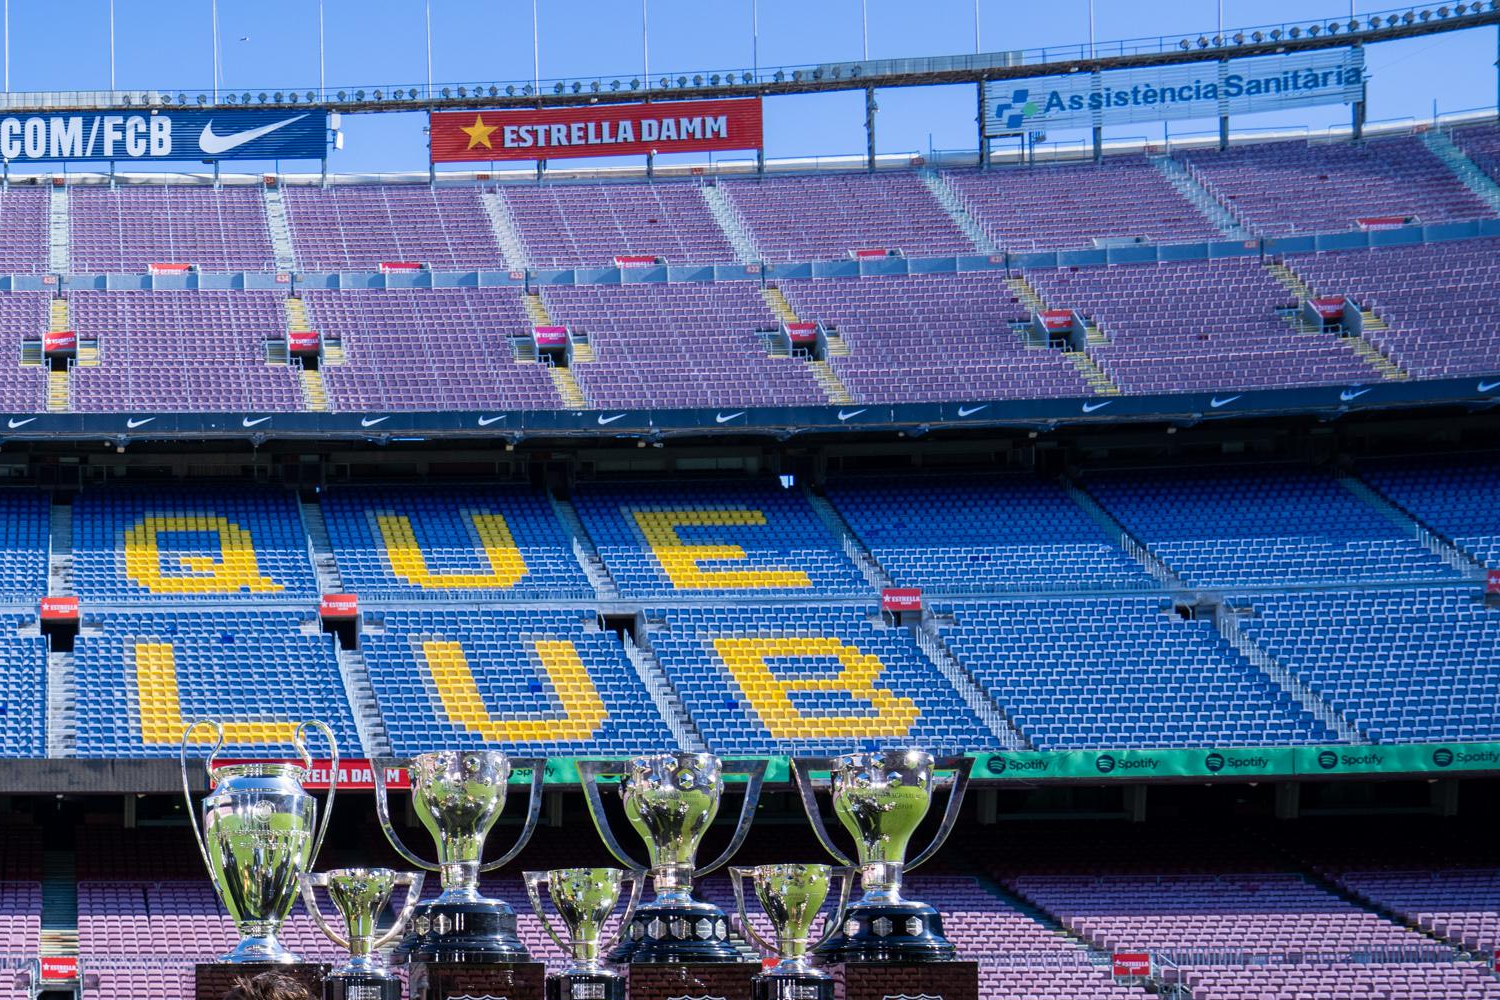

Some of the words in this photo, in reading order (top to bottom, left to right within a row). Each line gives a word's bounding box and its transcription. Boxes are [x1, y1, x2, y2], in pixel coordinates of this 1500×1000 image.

[1044, 81, 1218, 113] Assistència
[1222, 66, 1364, 99] Sanitària
[503, 121, 635, 148] ESTRELLA
[641, 115, 728, 141] DAMM
[124, 509, 813, 595] QUE
[1117, 757, 1159, 771] Spotify
[1227, 756, 1269, 770] Spotify
[1340, 753, 1383, 767] Spotify
[1456, 751, 1500, 764] Spotify
[1008, 758, 1049, 772] Spotify
[351, 768, 400, 783] DAM
